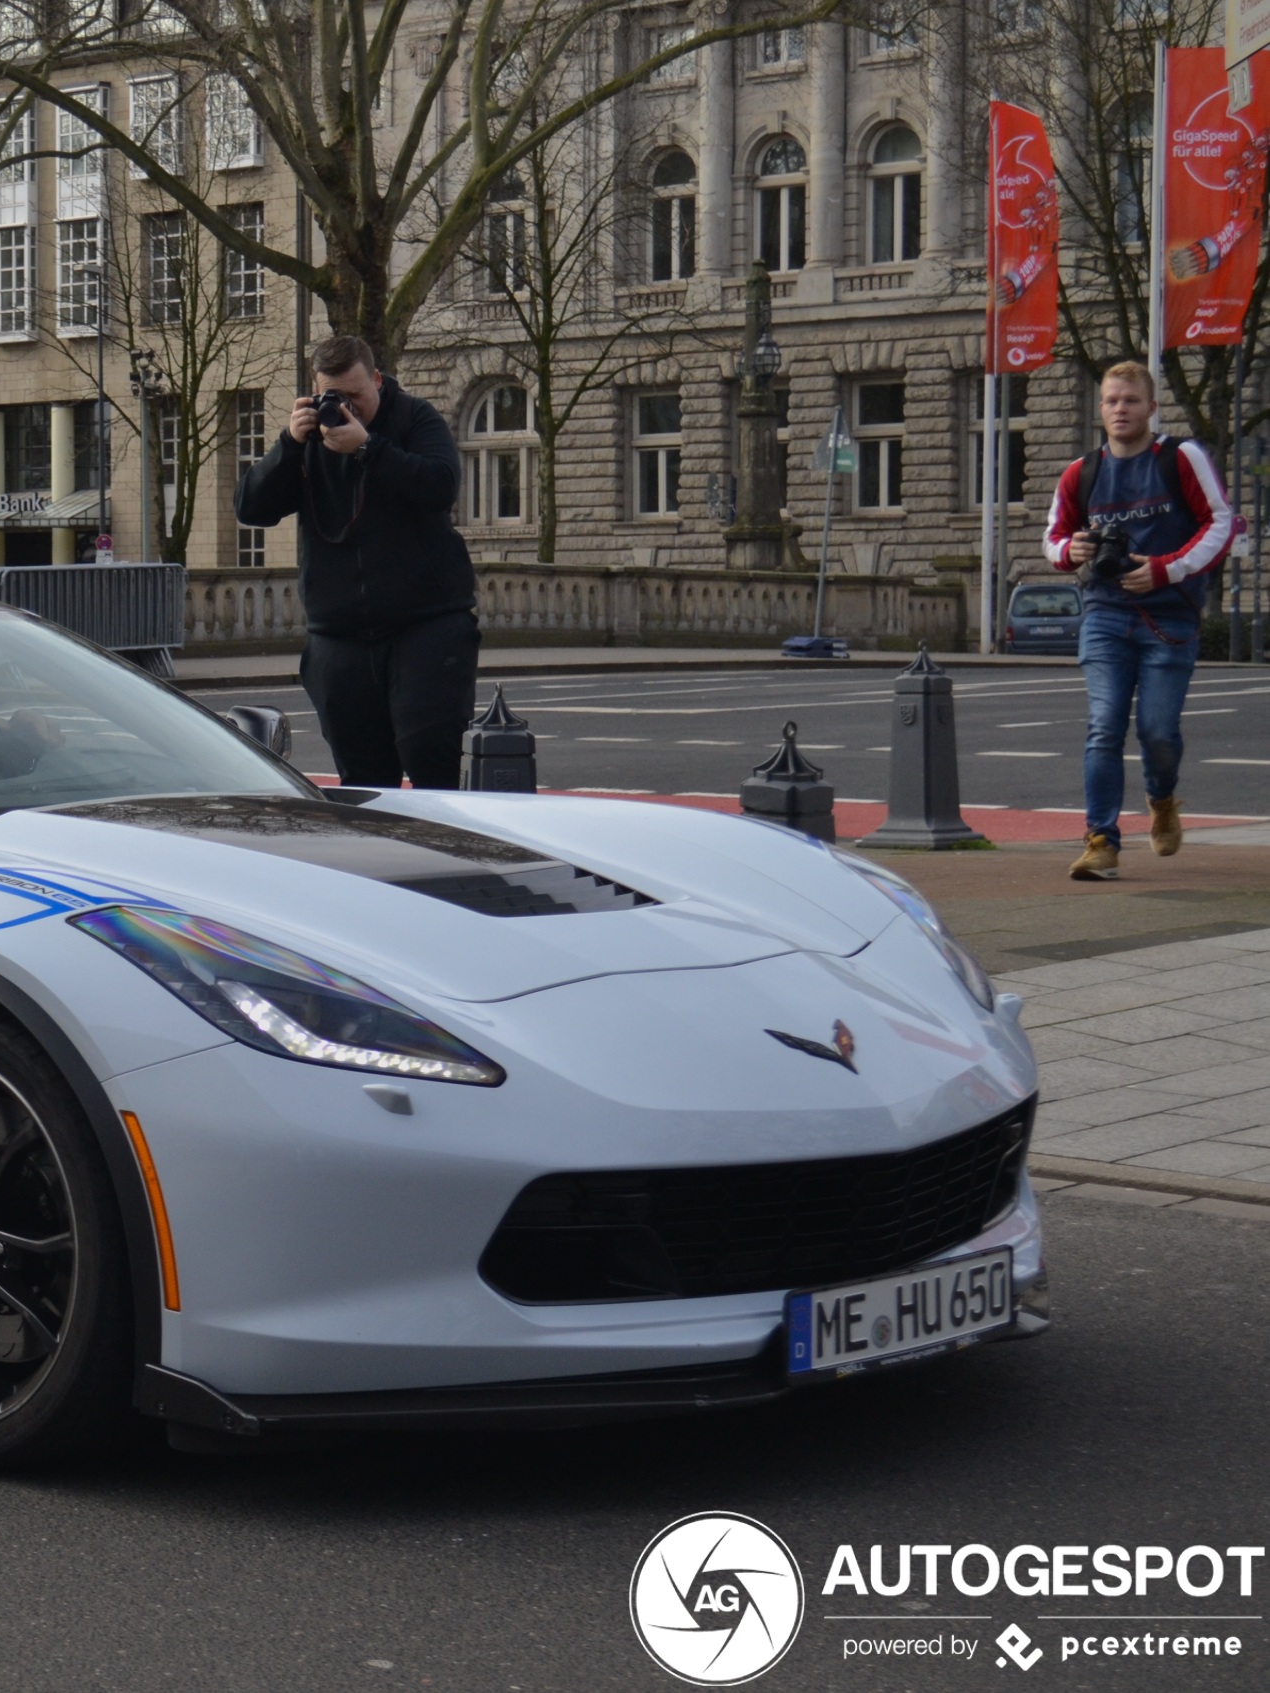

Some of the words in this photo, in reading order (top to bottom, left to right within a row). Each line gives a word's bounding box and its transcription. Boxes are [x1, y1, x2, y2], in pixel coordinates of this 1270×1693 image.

[1172, 129, 1239, 145] GigaSpeed
[1172, 145, 1192, 158] für
[1194, 145, 1222, 158] alle!
[50, 892, 90, 908] 65
[816, 1292, 868, 1359] ME
[897, 1276, 942, 1342] HU
[950, 1261, 1007, 1328] 650
[795, 1342, 805, 1359] D
